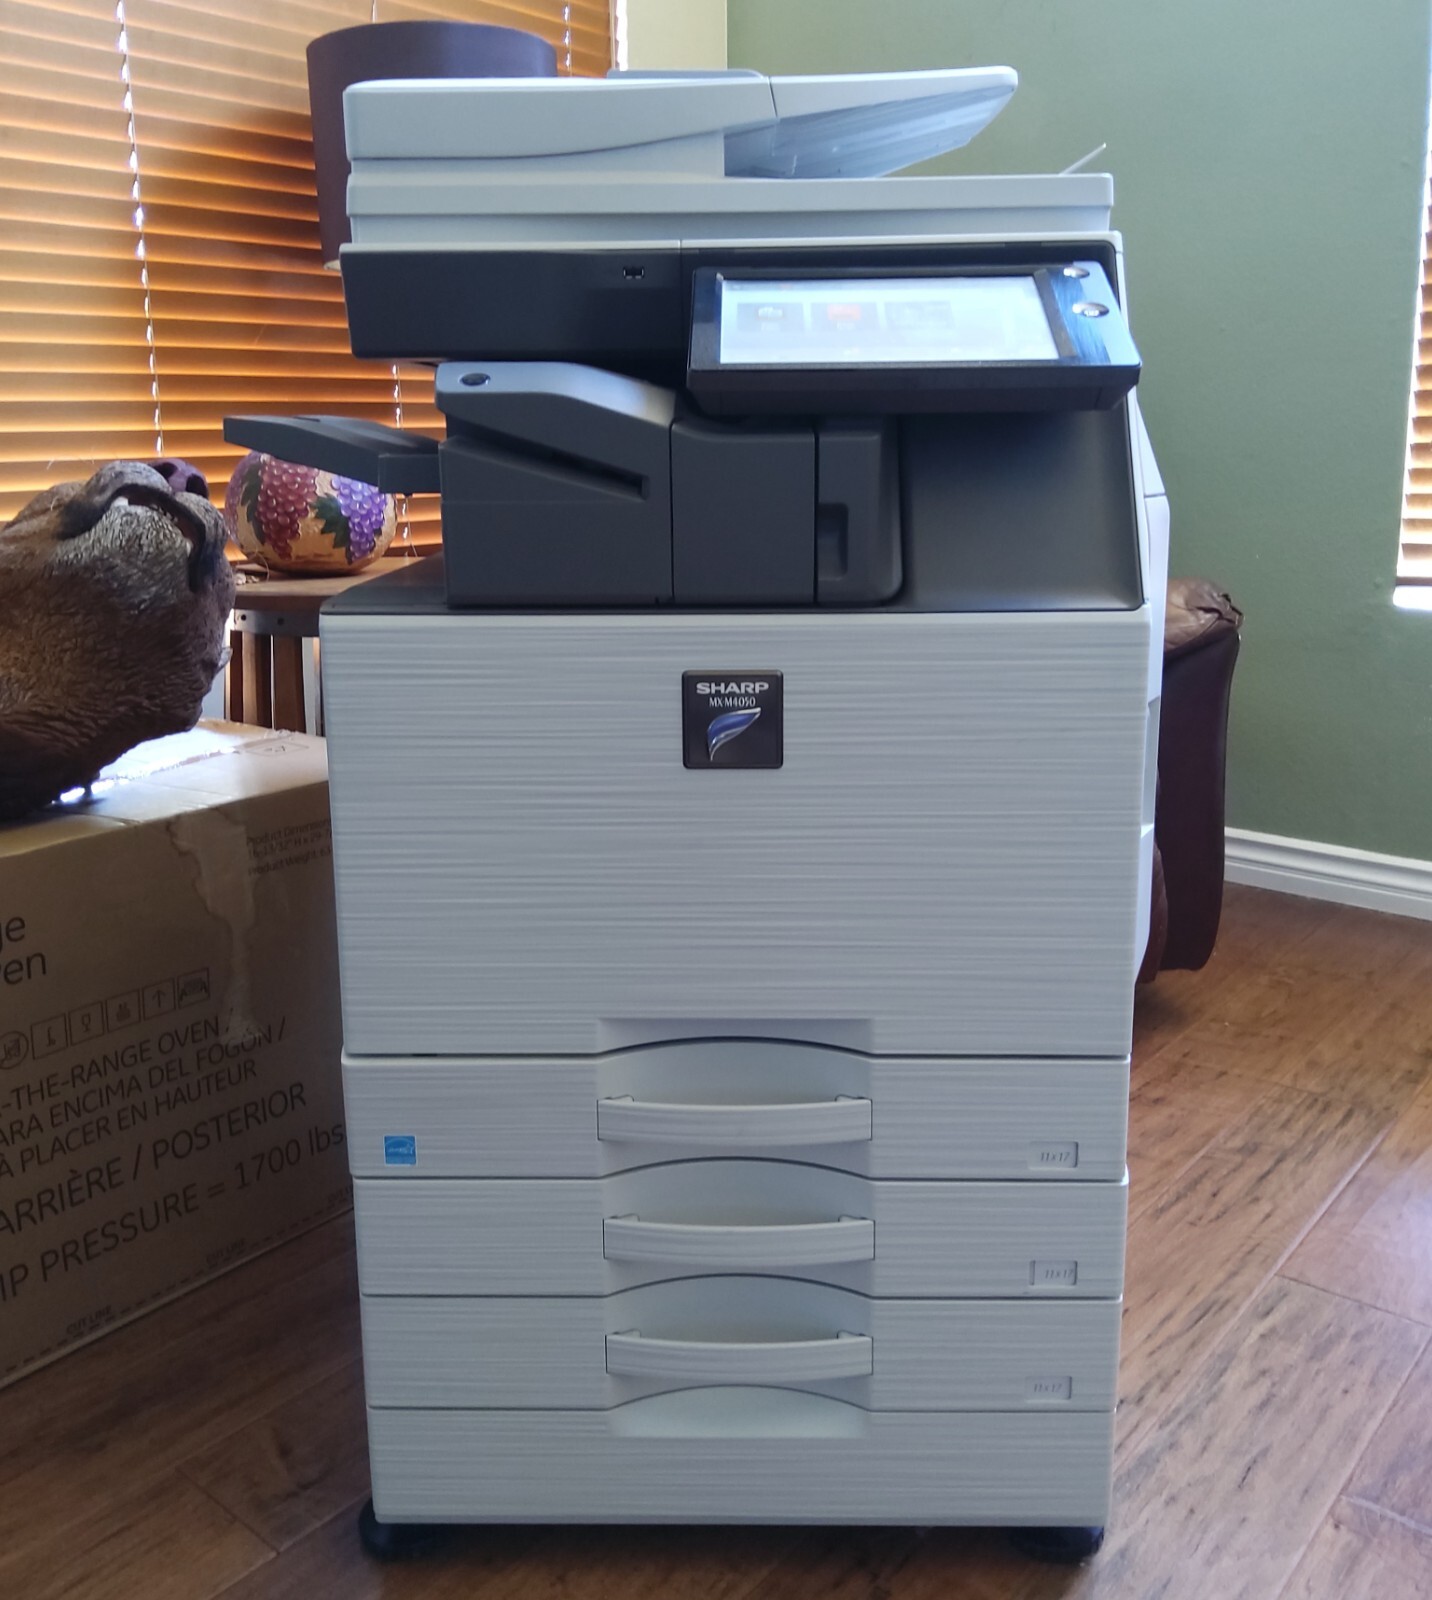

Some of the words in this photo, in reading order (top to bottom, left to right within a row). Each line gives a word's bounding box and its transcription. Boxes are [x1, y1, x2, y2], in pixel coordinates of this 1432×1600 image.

[696, 682, 769, 694] SHARP
[0, 952, 47, 985] en
[0, 1039, 152, 1117] -THE-RANGE
[157, 1016, 219, 1054] OVEN
[20, 1117, 112, 1173] PLACER
[117, 1100, 148, 1132] EN
[154, 1059, 257, 1117] HAUTEUR
[49, 1075, 142, 1129] ENCIMA
[147, 1057, 191, 1089] DEL
[278, 1015, 286, 1041] /
[0, 1156, 125, 1234] ARRIÈRE
[132, 1143, 142, 1181] /
[152, 1081, 307, 1168] POSTERIOR
[40, 1183, 200, 1282] PRESSURE
[207, 1182, 226, 1199] =
[233, 1138, 301, 1190] 1700
[308, 1123, 344, 1157] lbs
